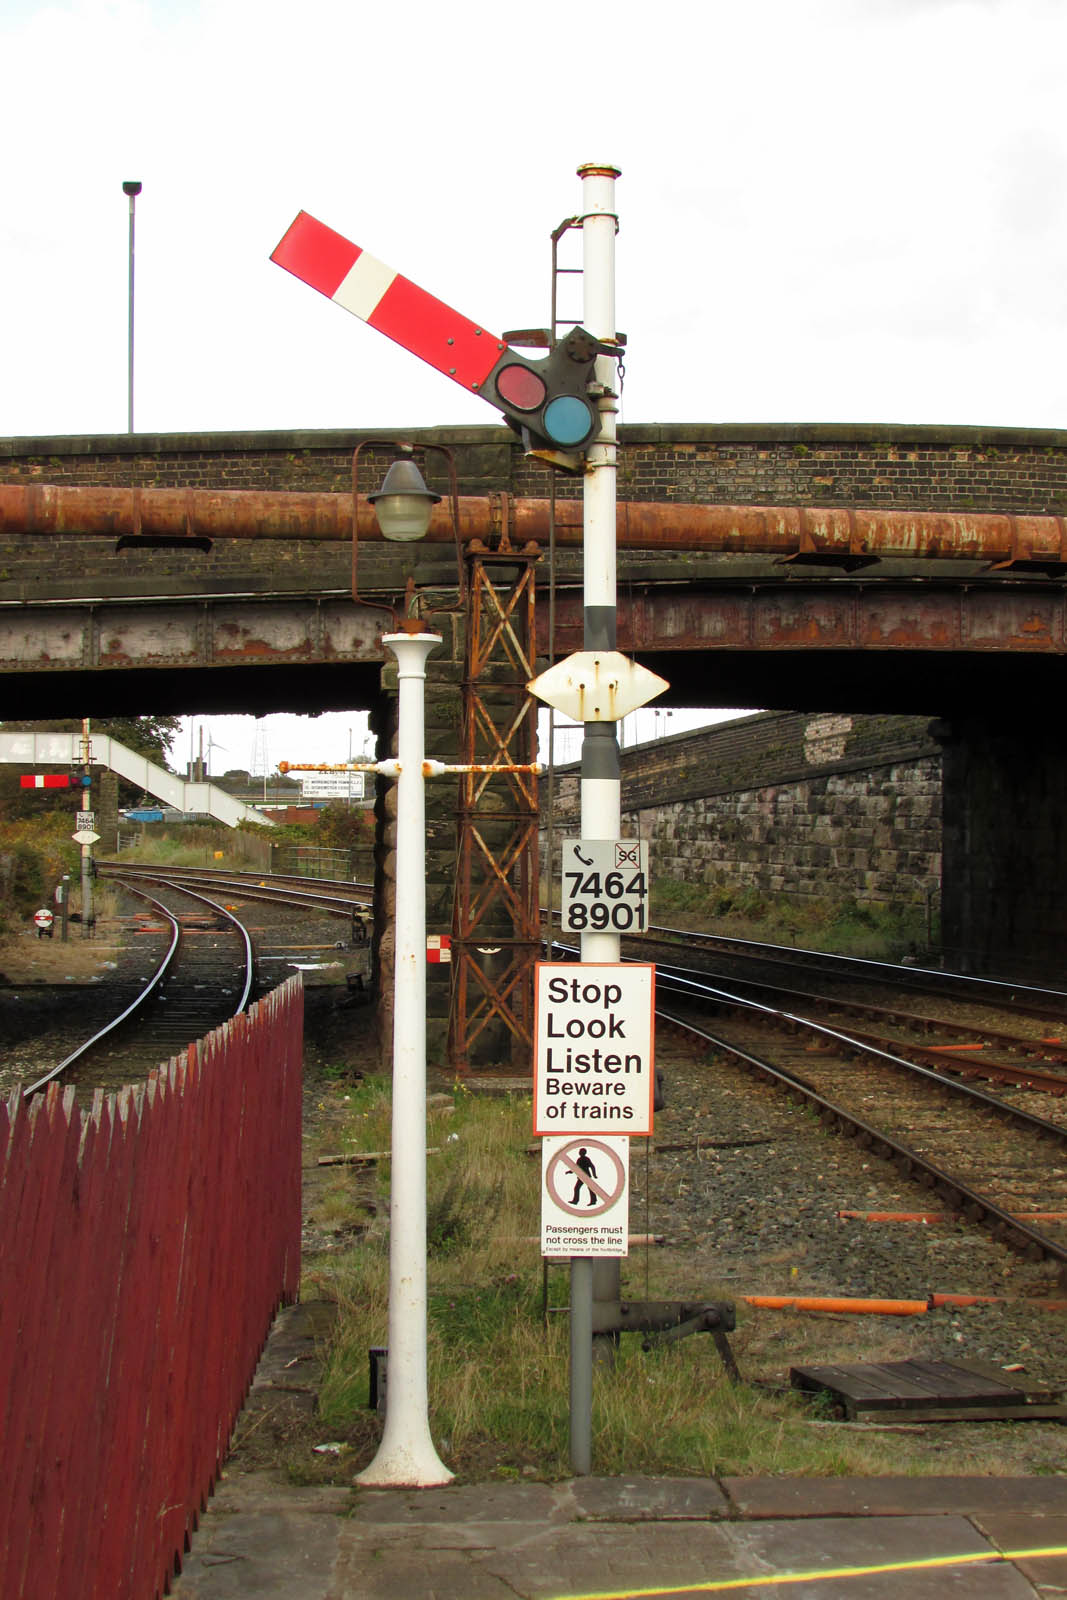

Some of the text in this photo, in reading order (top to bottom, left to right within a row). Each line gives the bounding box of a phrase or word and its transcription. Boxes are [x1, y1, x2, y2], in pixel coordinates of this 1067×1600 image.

[618, 850, 637, 862] SG
[565, 872, 648, 899] 7464
[568, 902, 644, 930] 8901
[547, 977, 622, 1009] Stop
[547, 1013, 626, 1038] Look
[546, 1048, 642, 1074] Listen
[546, 1078, 626, 1095] Beware
[546, 1102, 634, 1119] of trains
[545, 1225, 623, 1235] Passengers must
[590, 1237, 605, 1245] the
[607, 1237, 623, 1245] line
